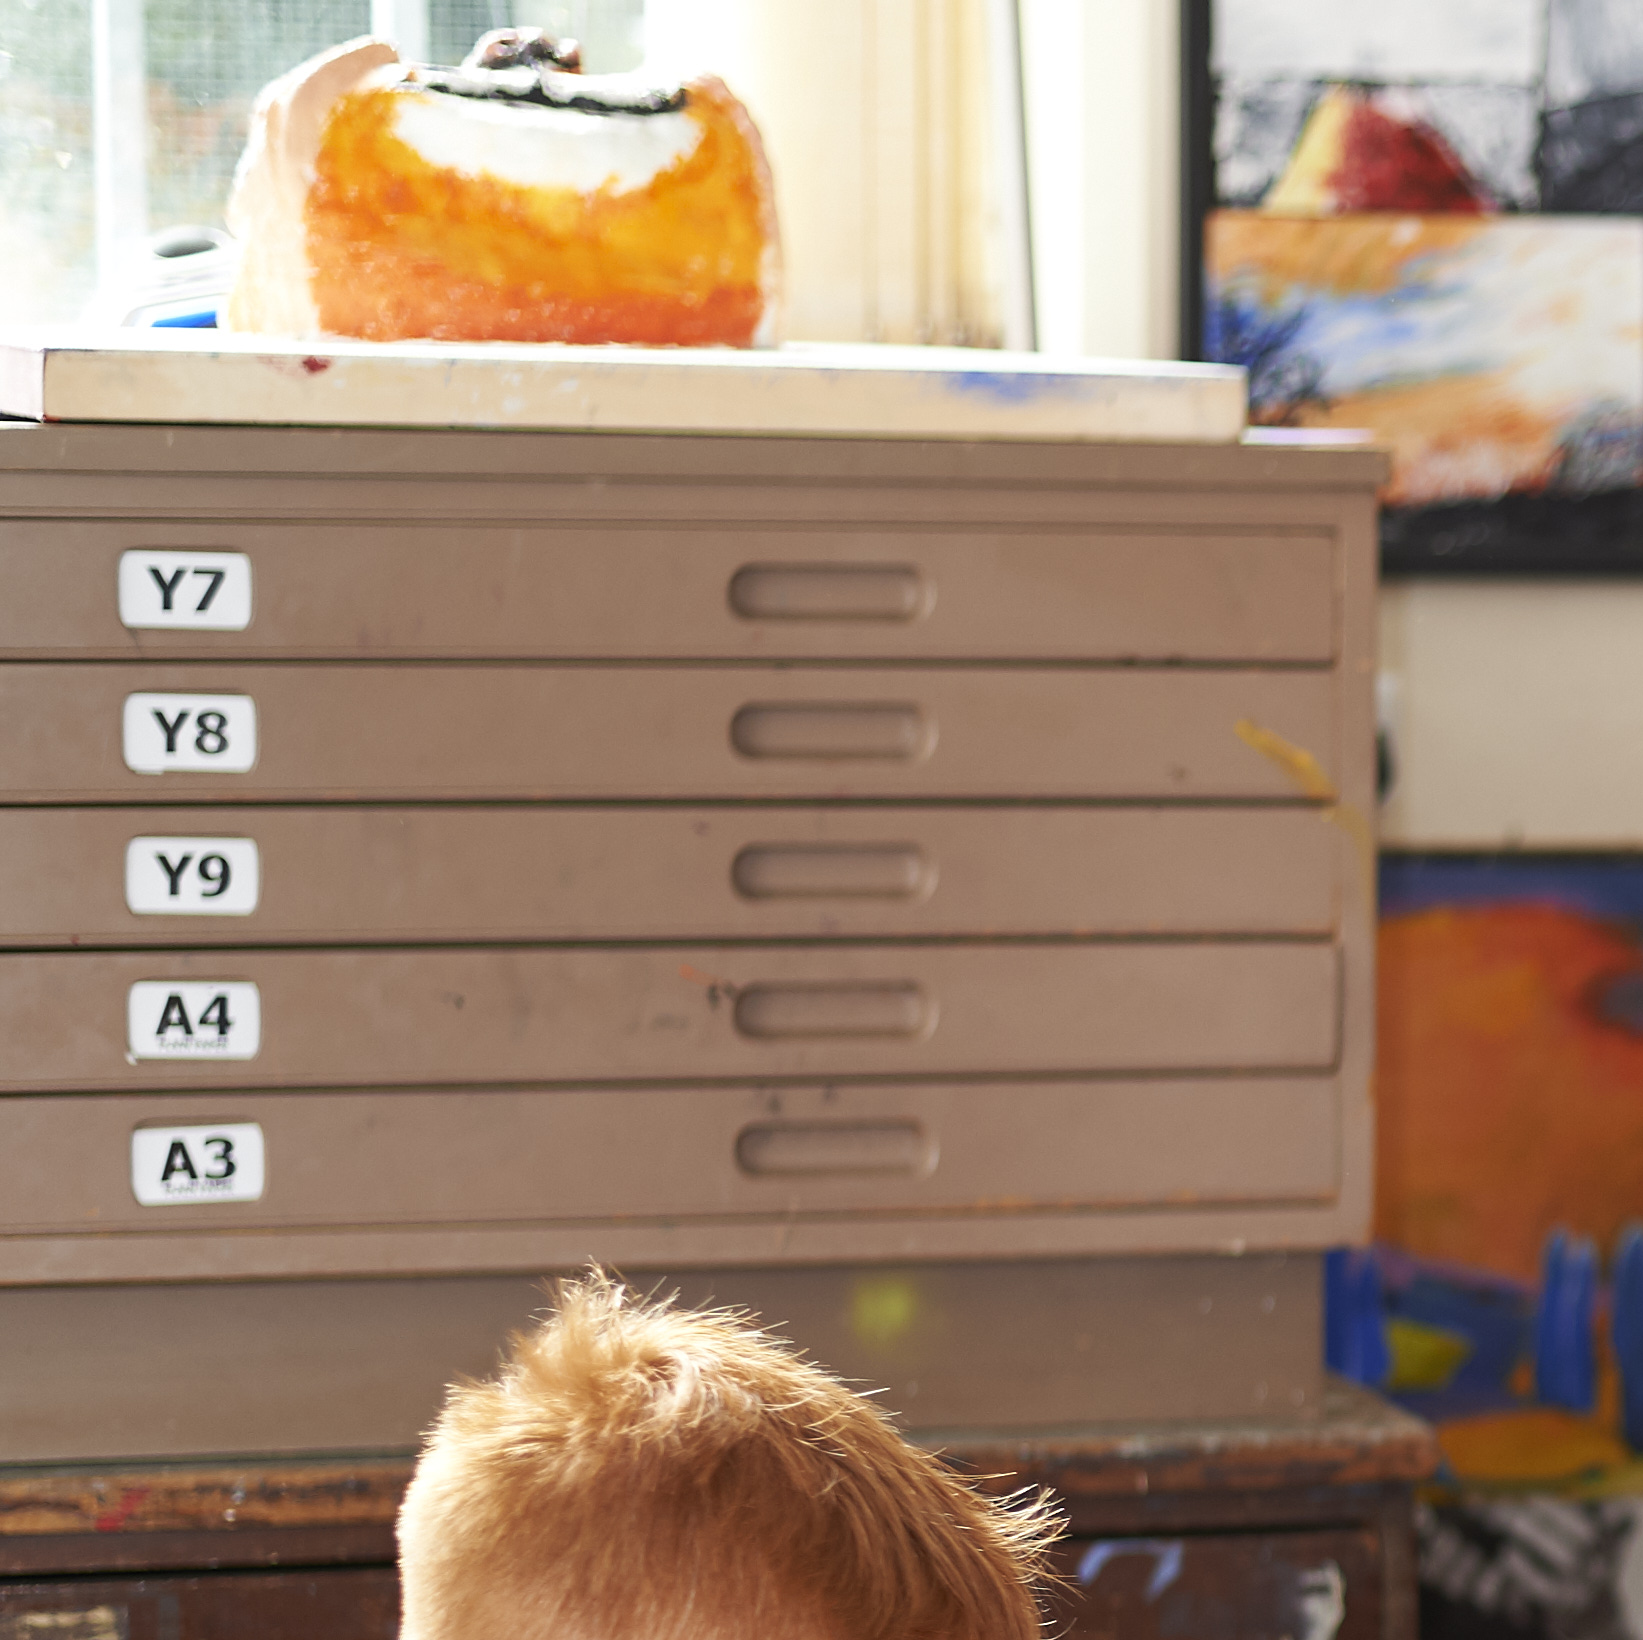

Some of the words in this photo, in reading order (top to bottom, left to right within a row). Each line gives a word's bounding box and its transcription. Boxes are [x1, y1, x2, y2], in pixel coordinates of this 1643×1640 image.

[147, 565, 226, 613] Y7
[152, 709, 230, 755] Y8
[155, 852, 232, 899] Y9
[155, 993, 234, 1036] A4
[160, 1137, 237, 1182] A3
